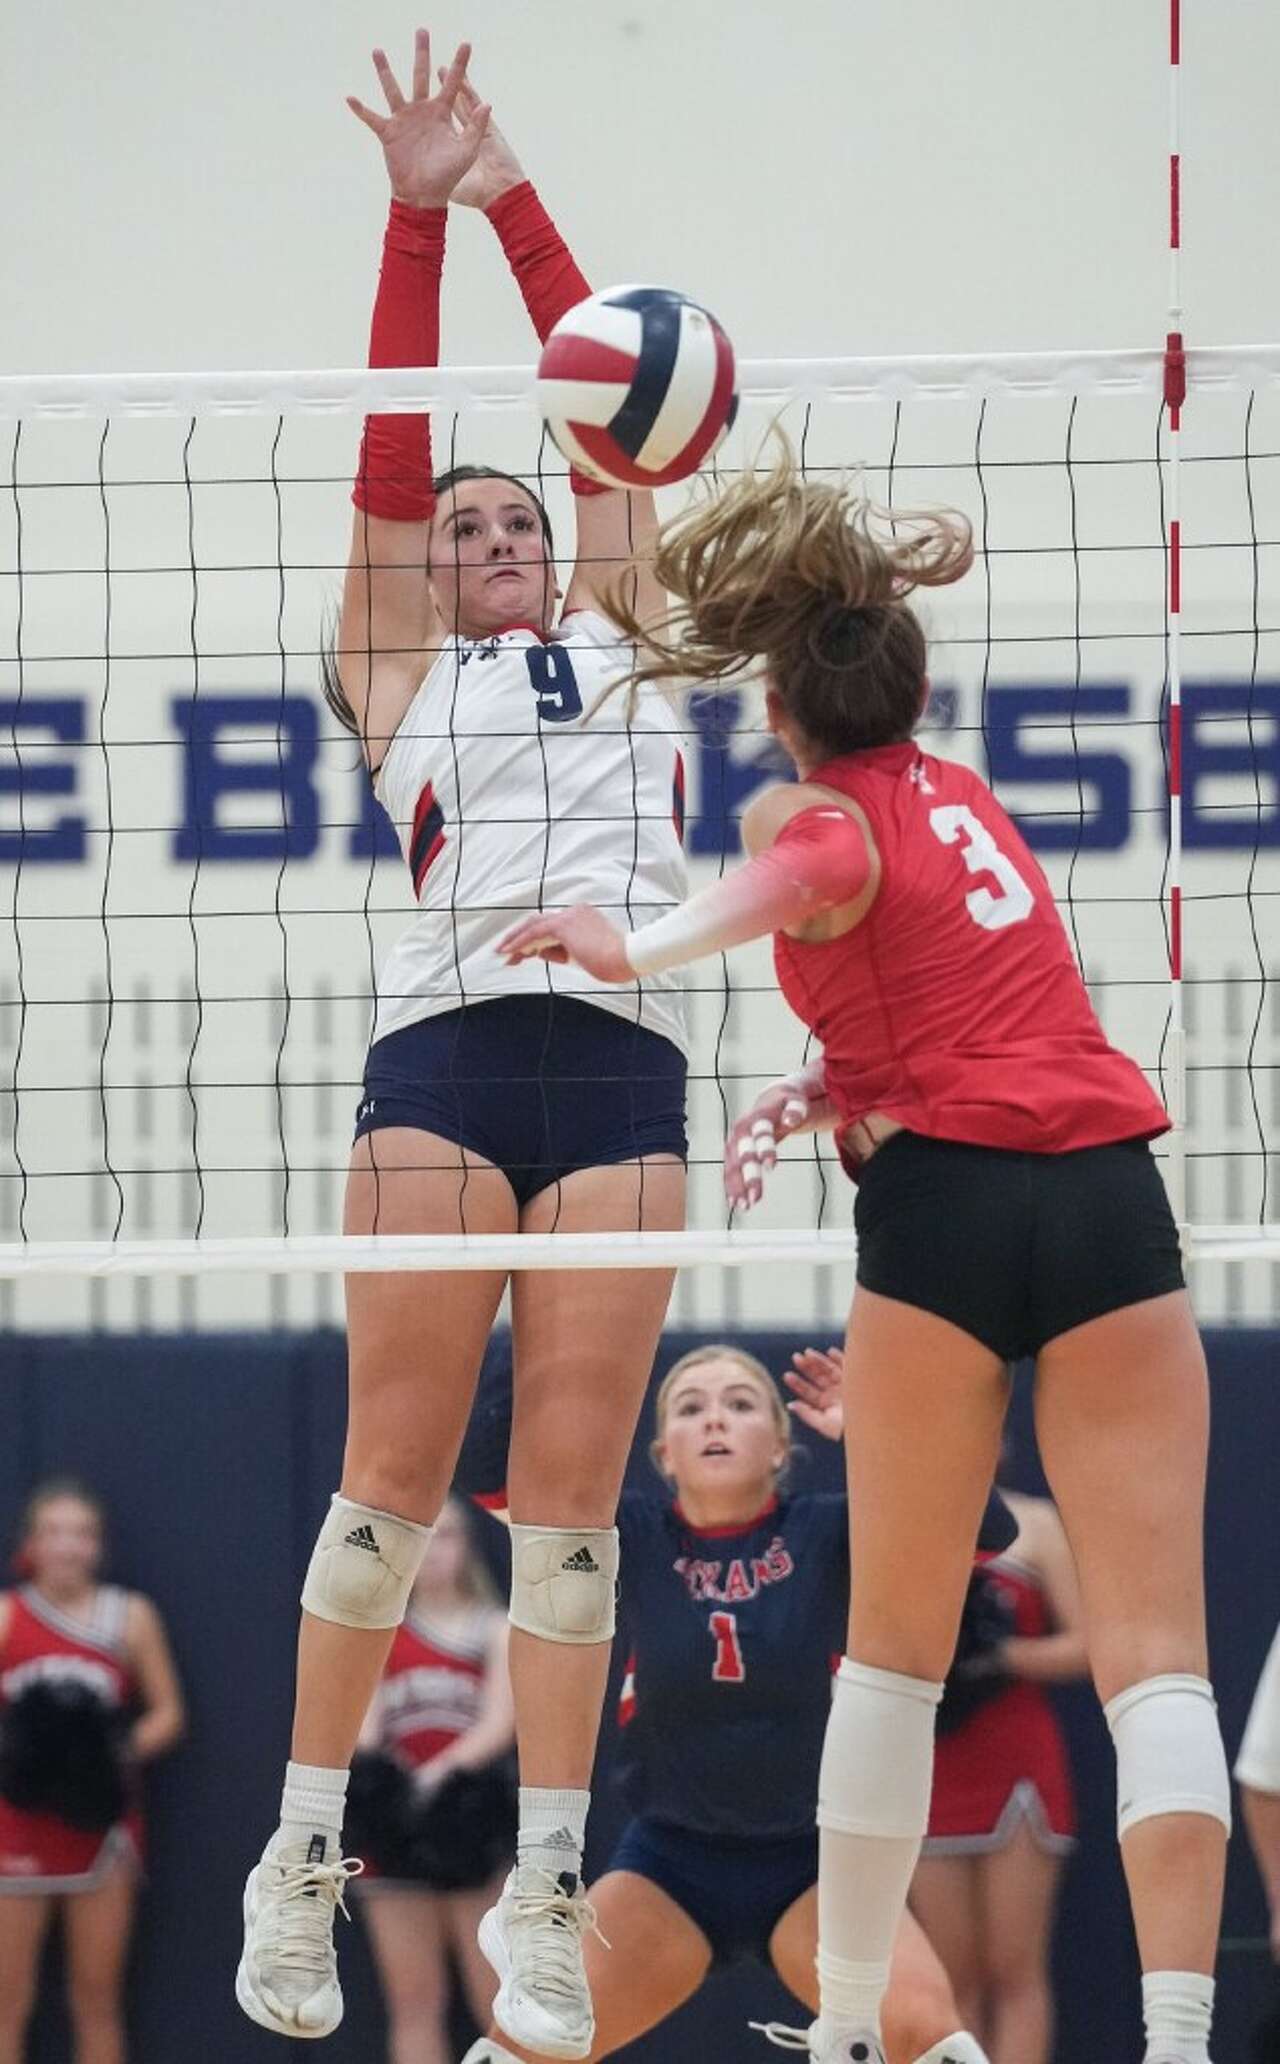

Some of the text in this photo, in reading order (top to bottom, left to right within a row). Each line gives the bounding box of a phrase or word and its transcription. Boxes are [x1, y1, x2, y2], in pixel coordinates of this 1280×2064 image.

[526, 644, 583, 722] 9
[930, 804, 1035, 931] 3
[709, 1611, 745, 1682] 1
